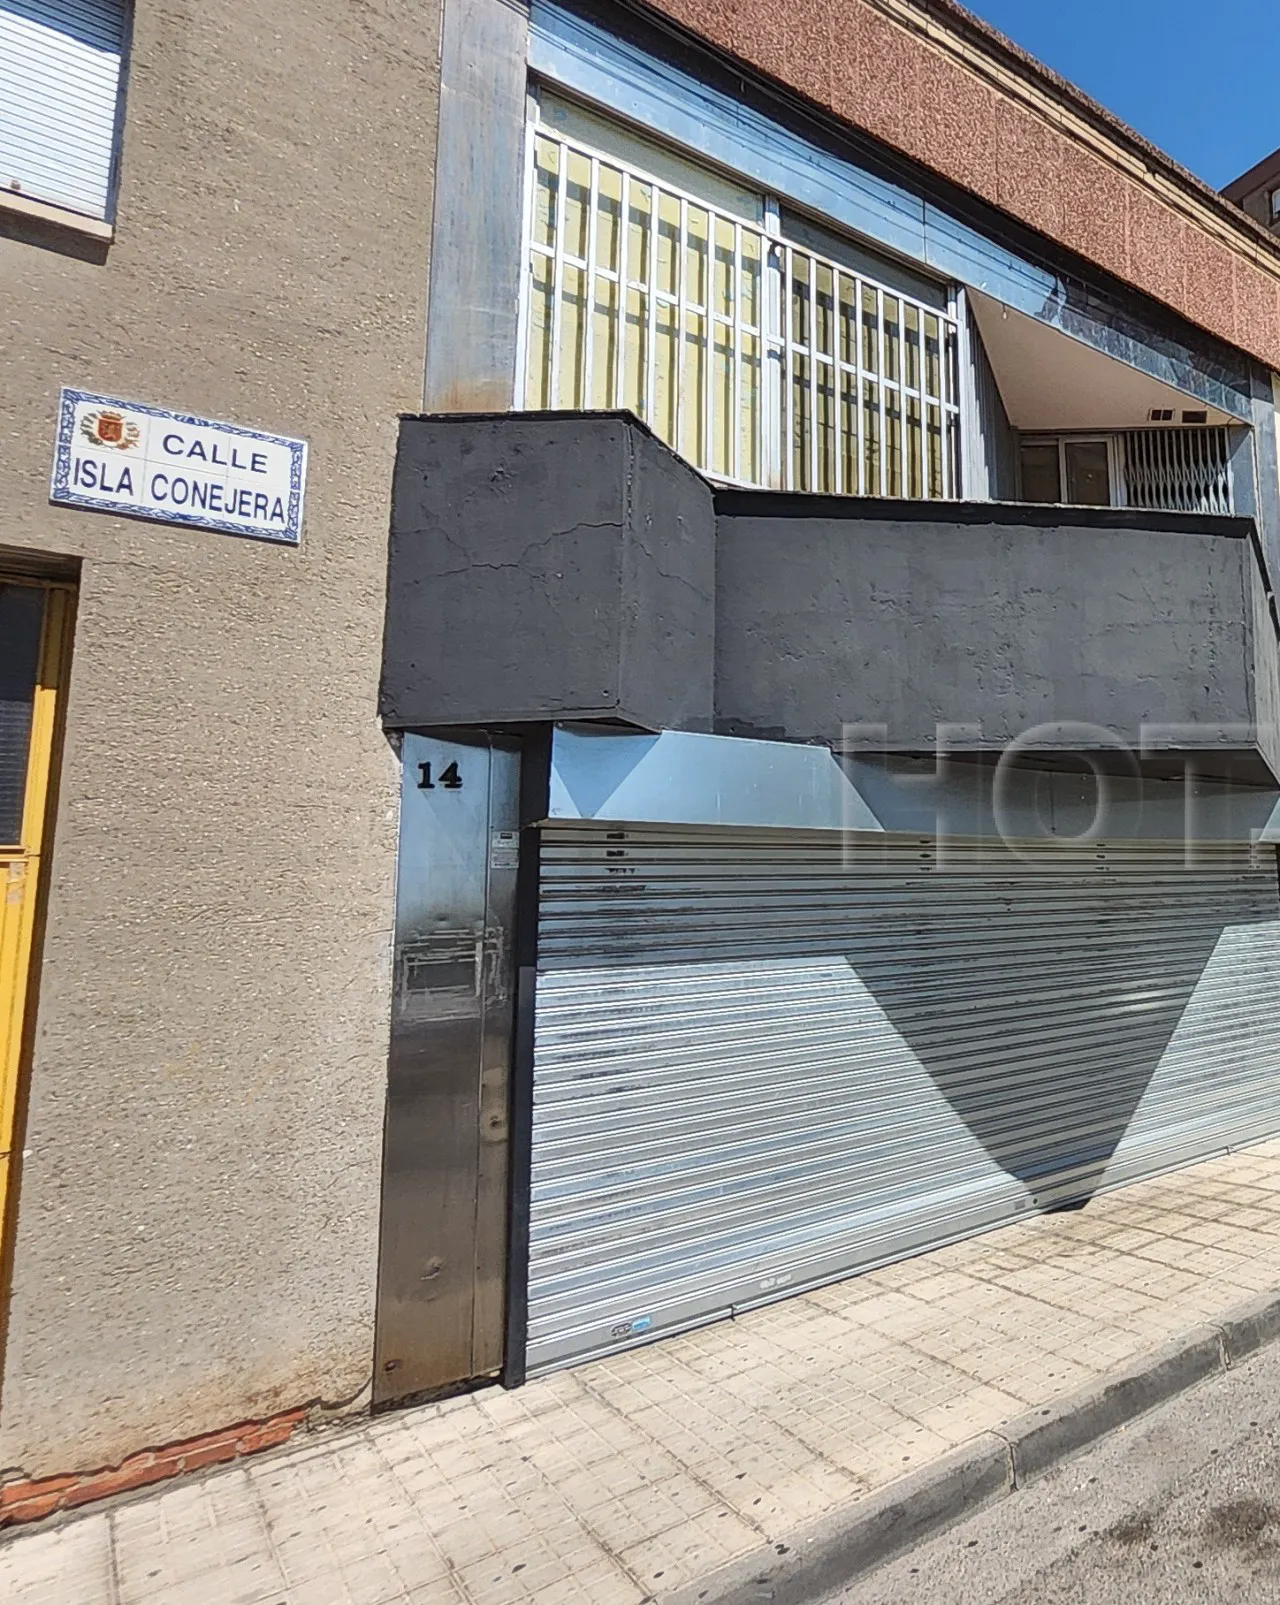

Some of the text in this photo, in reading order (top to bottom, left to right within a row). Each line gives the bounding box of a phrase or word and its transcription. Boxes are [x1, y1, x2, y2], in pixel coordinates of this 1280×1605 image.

[162, 433, 268, 474] CALLE
[72, 457, 287, 524] ISLA CONEJERA
[416, 760, 464, 790] 14
